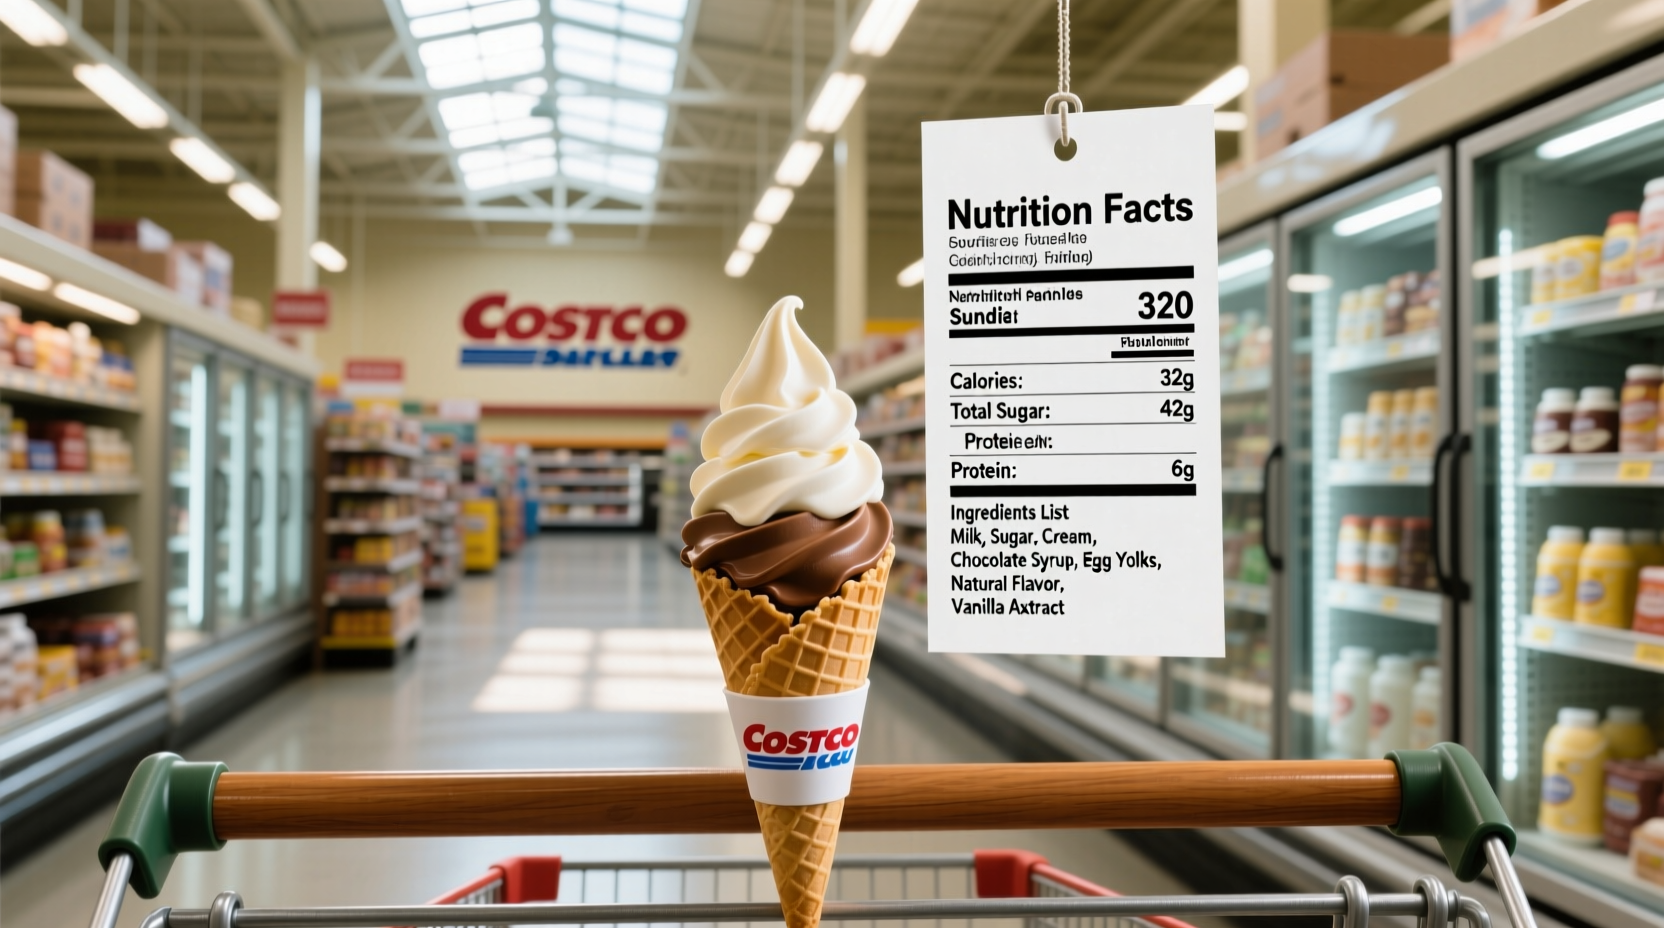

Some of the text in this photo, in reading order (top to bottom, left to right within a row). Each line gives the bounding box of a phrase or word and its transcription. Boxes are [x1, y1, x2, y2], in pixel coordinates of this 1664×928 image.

[948, 193, 1194, 230] Nutrition Facts
[1138, 290, 1194, 319] 320
[462, 293, 687, 342] COSTCO
[950, 368, 1195, 391] Calories: 32g
[950, 399, 1195, 423] Total Sugar: 42g
[951, 459, 1195, 482] Protein: 6g
[950, 503, 1070, 525] Ingredients List
[950, 527, 986, 549] Milk,
[1042, 528, 1097, 547] Cream,
[950, 550, 1162, 573] Chocolate Syrup, Egg Yolks,
[951, 575, 1065, 593] Natural Flavor,
[951, 597, 1065, 615] Vanilla Axtract
[743, 723, 859, 754] COSTCO
